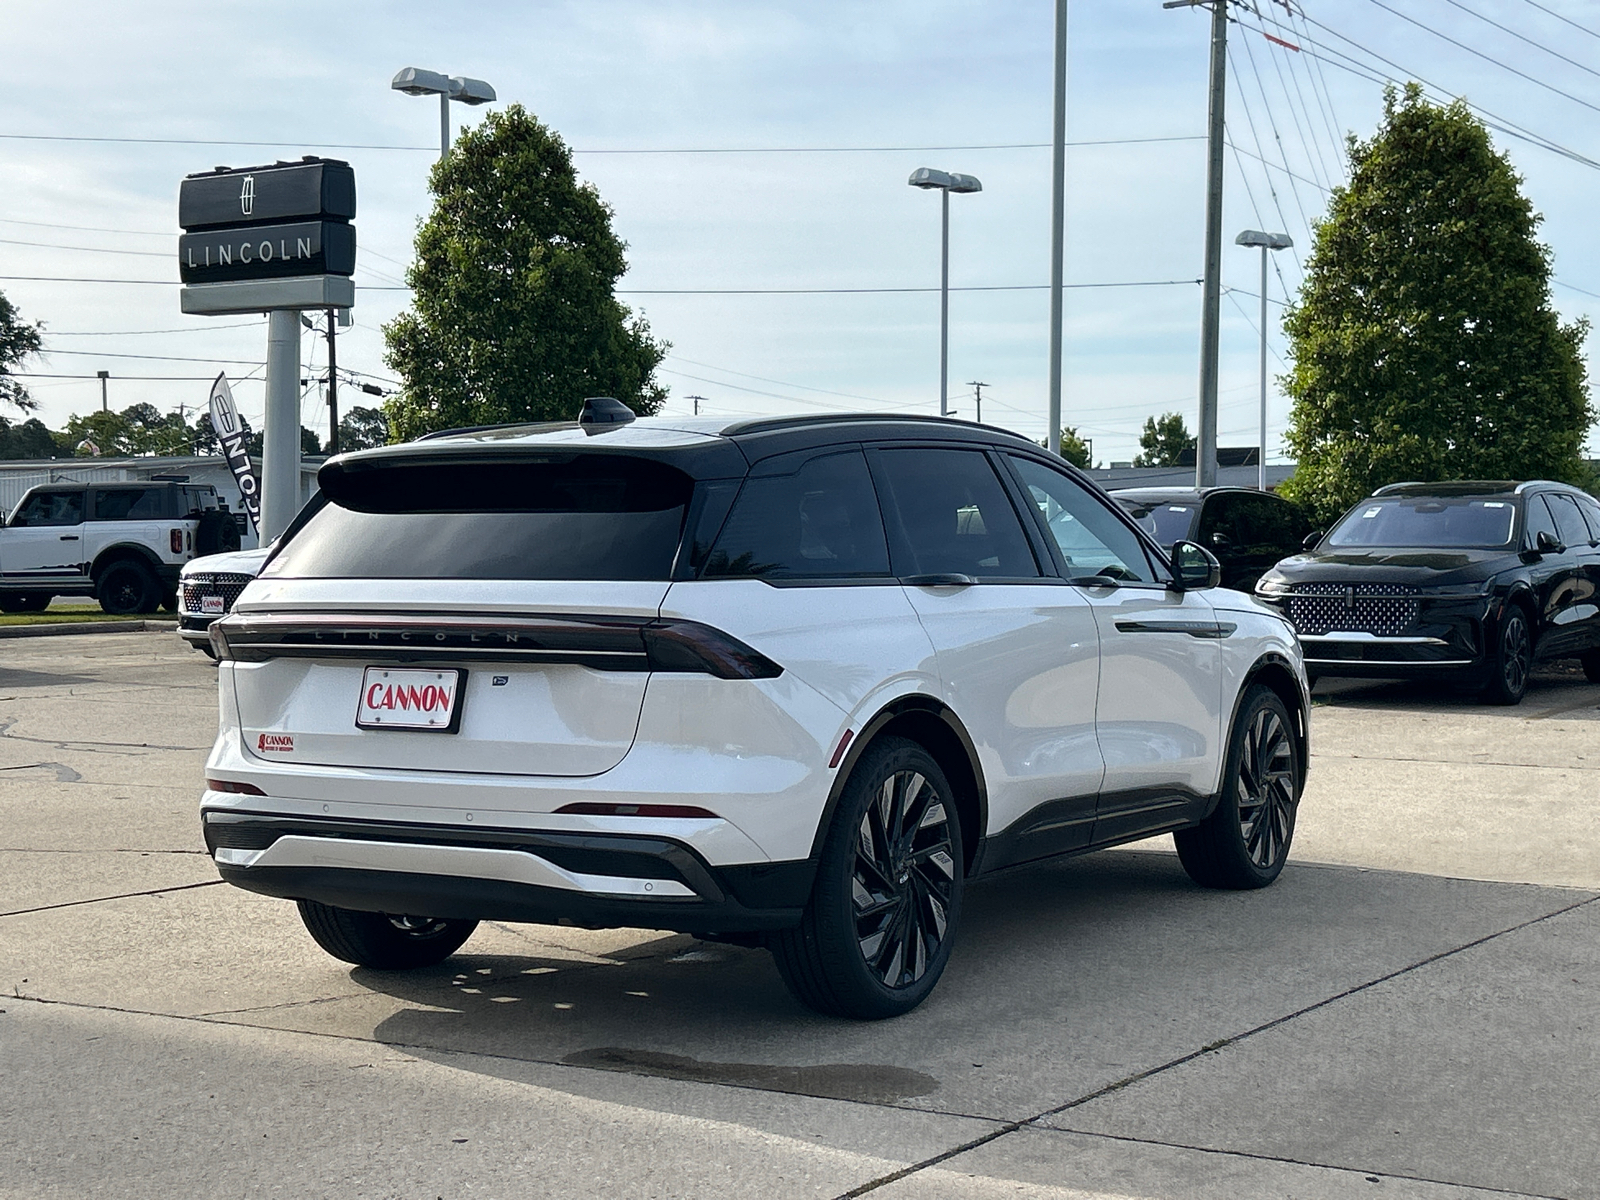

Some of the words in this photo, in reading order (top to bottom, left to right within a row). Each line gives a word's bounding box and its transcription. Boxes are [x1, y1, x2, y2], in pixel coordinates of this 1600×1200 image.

[188, 237, 312, 268] LINCOLN
[315, 631, 519, 642] LINCOLN
[367, 683, 453, 712] CANNON
[265, 735, 294, 746] CANNON
